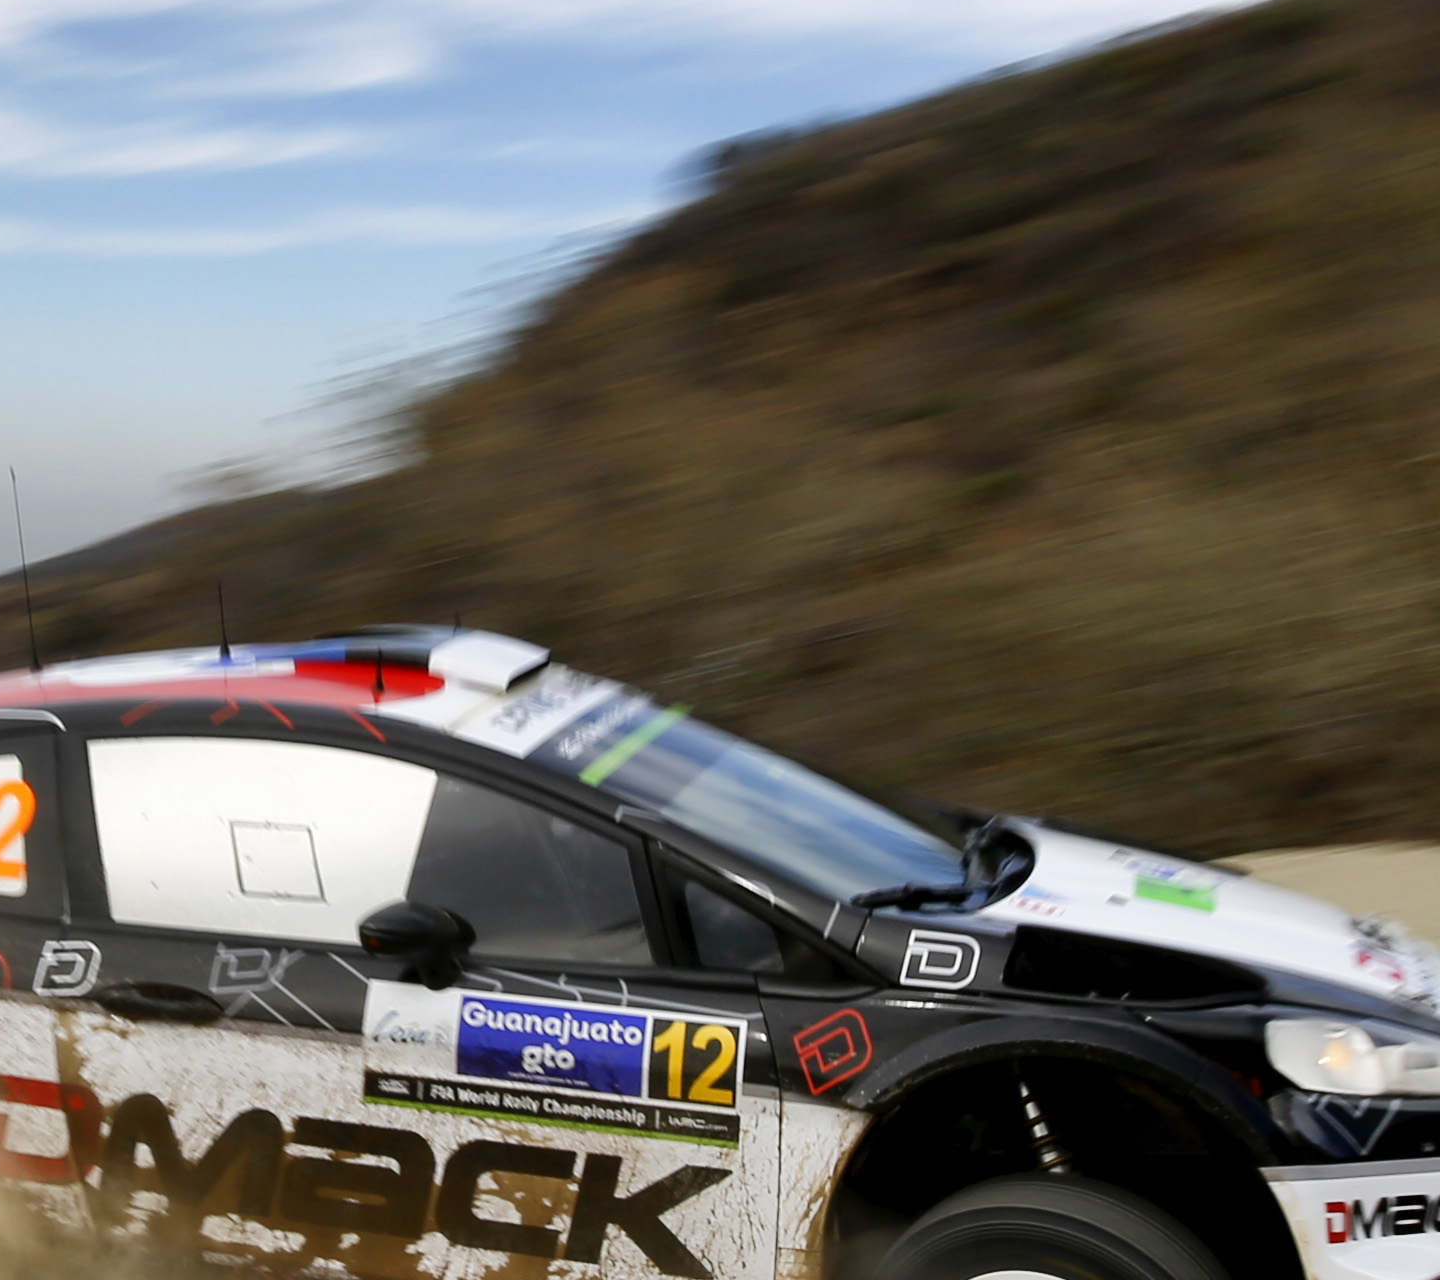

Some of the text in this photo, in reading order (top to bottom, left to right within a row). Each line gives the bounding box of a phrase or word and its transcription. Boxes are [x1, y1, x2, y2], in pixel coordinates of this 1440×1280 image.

[461, 1000, 643, 1047] Guanajuato
[521, 1042, 576, 1075] gto
[652, 1021, 737, 1106] 12
[456, 1086, 501, 1108] World
[502, 1092, 540, 1114] Rally
[542, 1097, 647, 1127] Championship
